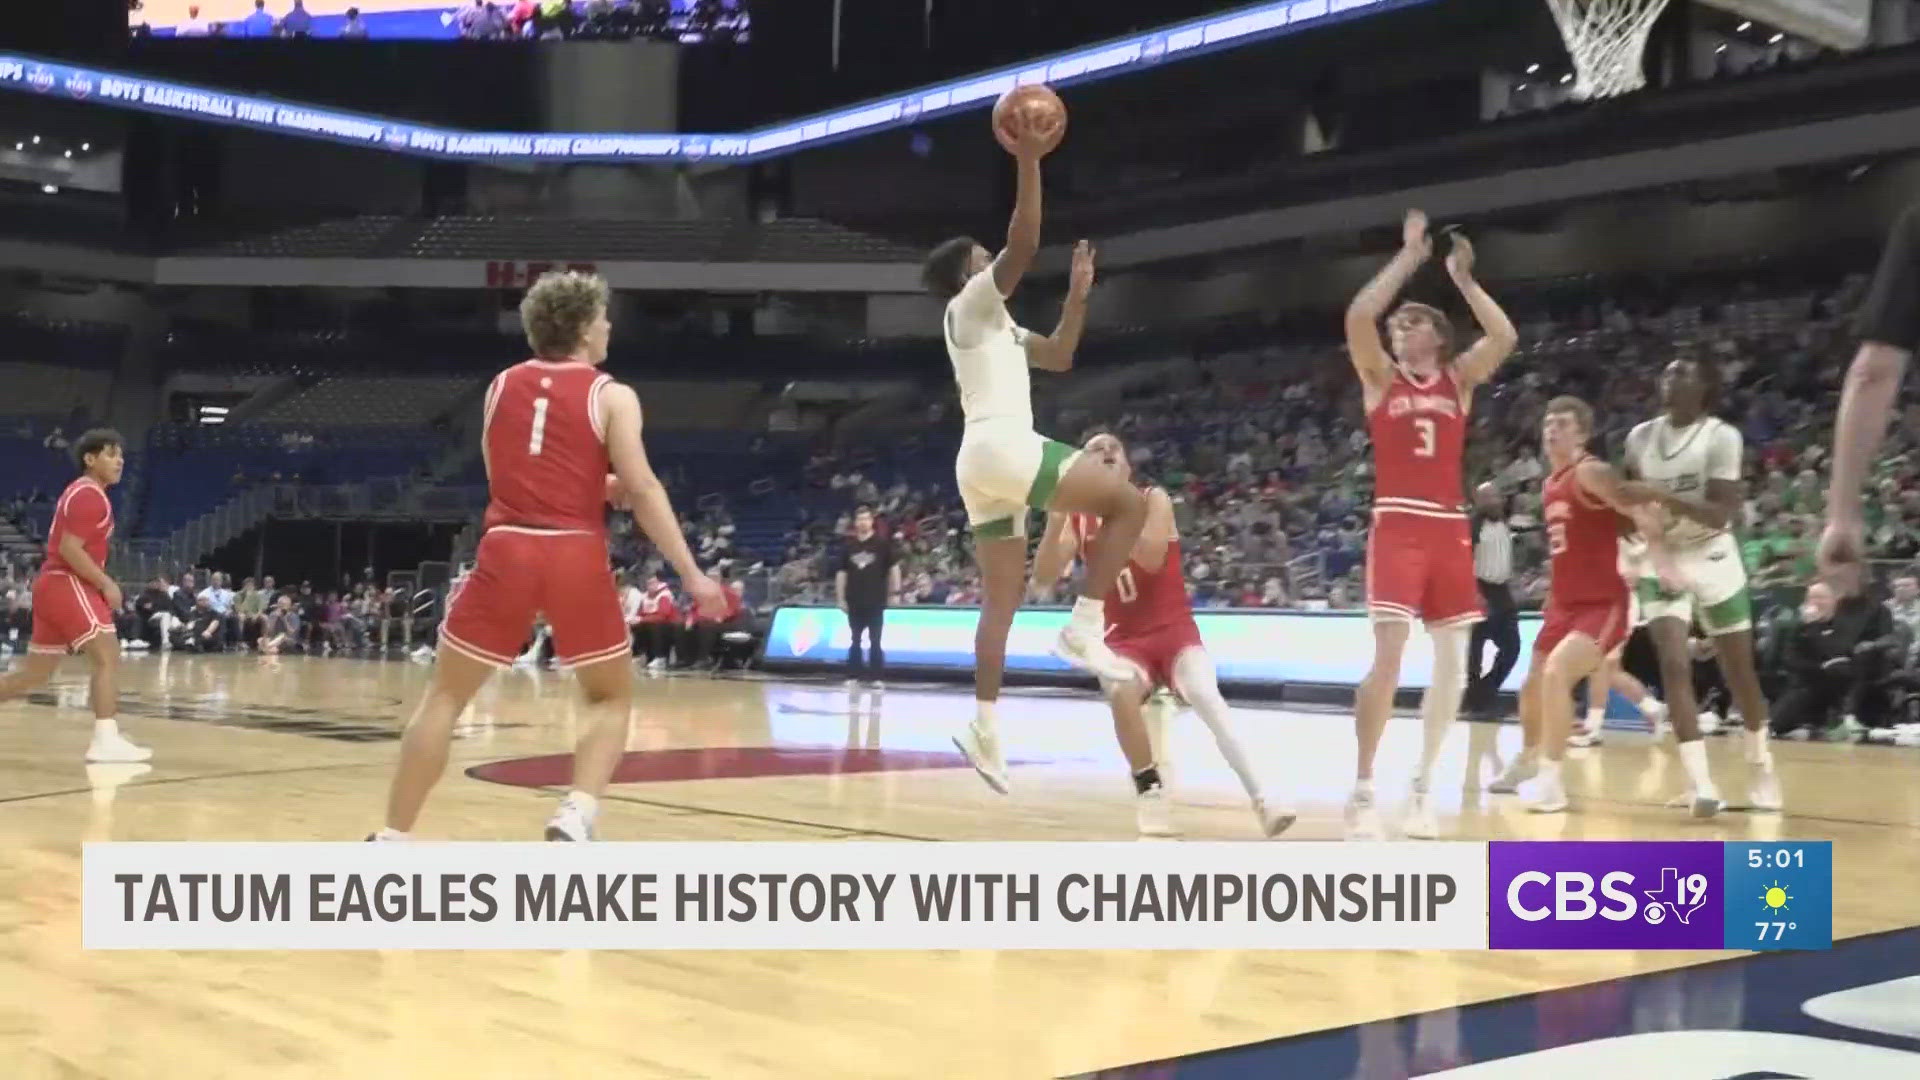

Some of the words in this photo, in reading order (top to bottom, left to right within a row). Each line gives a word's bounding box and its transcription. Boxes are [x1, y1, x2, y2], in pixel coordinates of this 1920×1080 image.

[100, 78, 142, 101] BOYS
[143, 86, 234, 118] BASKETBALL
[529, 397, 549, 456] 1
[1414, 418, 1435, 457] 3
